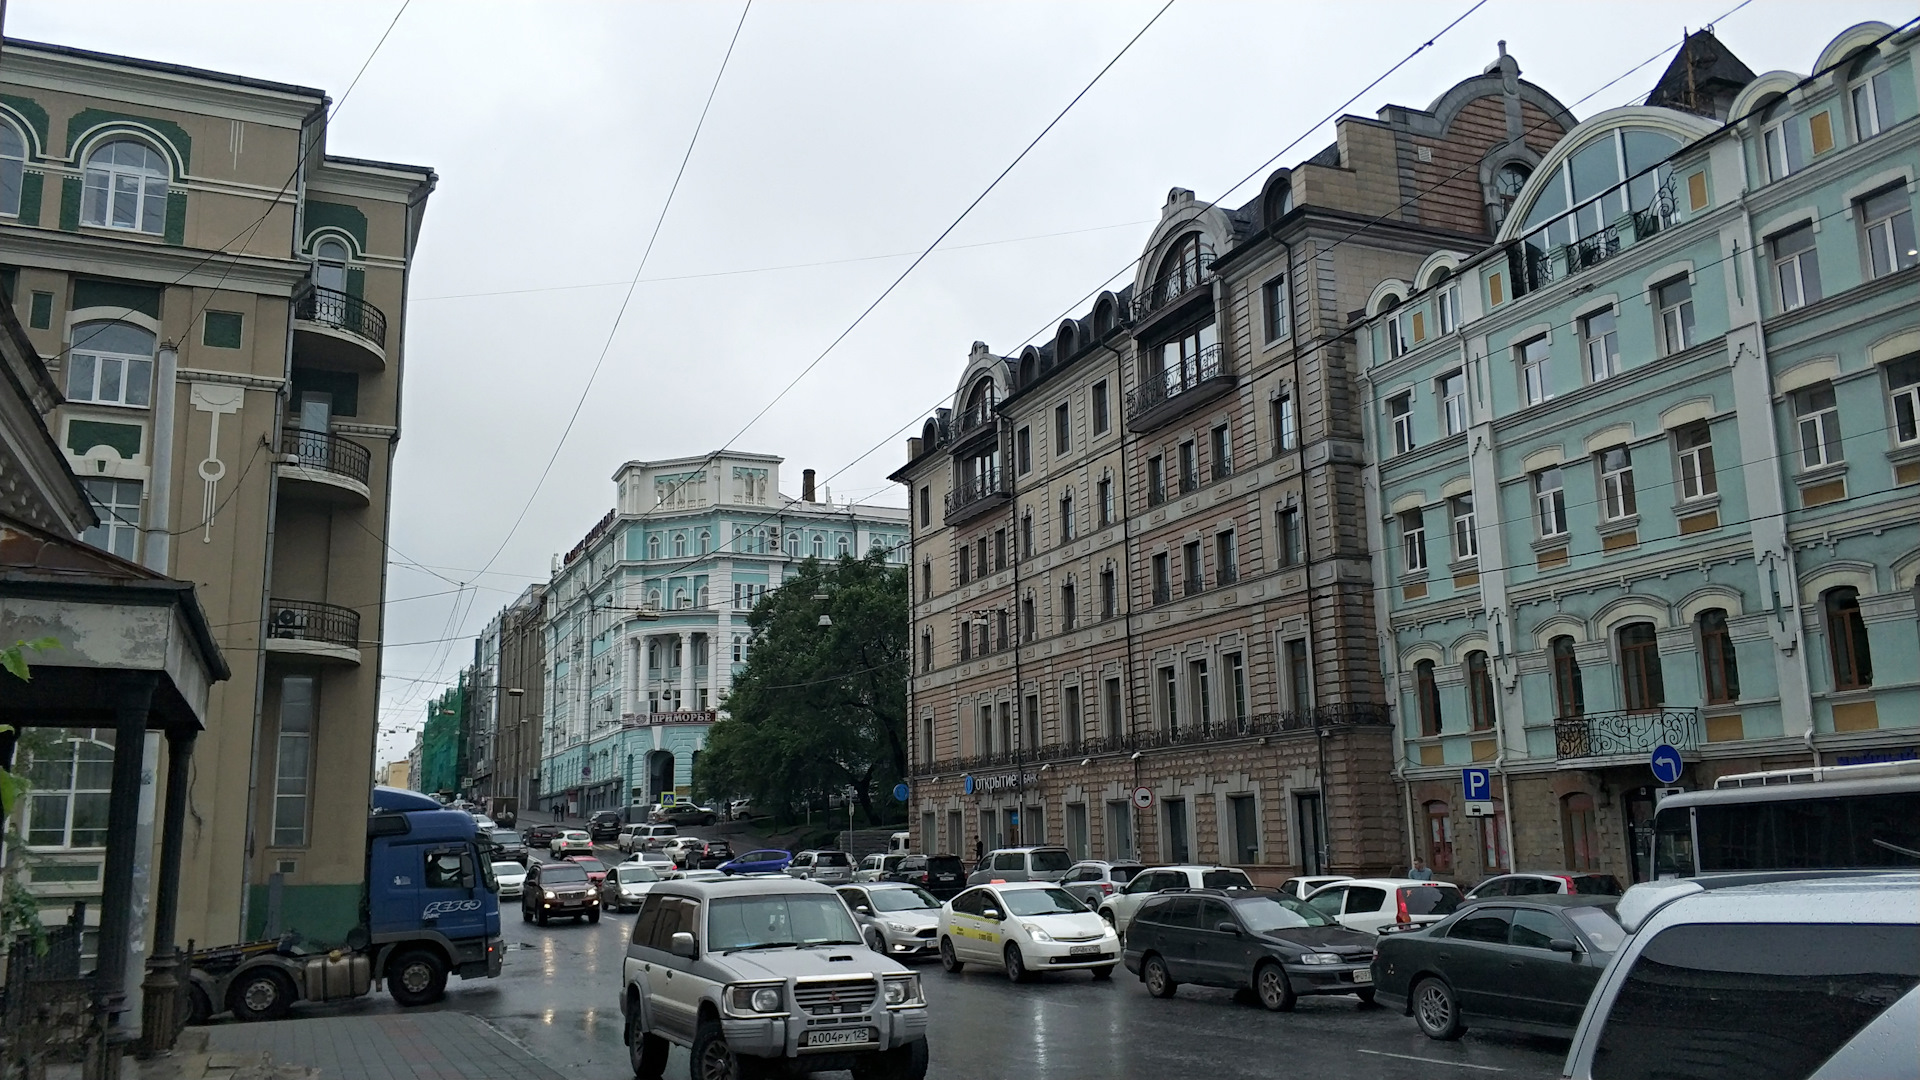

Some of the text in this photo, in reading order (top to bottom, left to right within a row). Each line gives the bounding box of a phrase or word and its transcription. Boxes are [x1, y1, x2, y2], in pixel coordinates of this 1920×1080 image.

[651, 712, 712, 723] ПРИМОРЬЕ
[975, 773, 1038, 794] открытие БАНК
[1469, 771, 1486, 798] P
